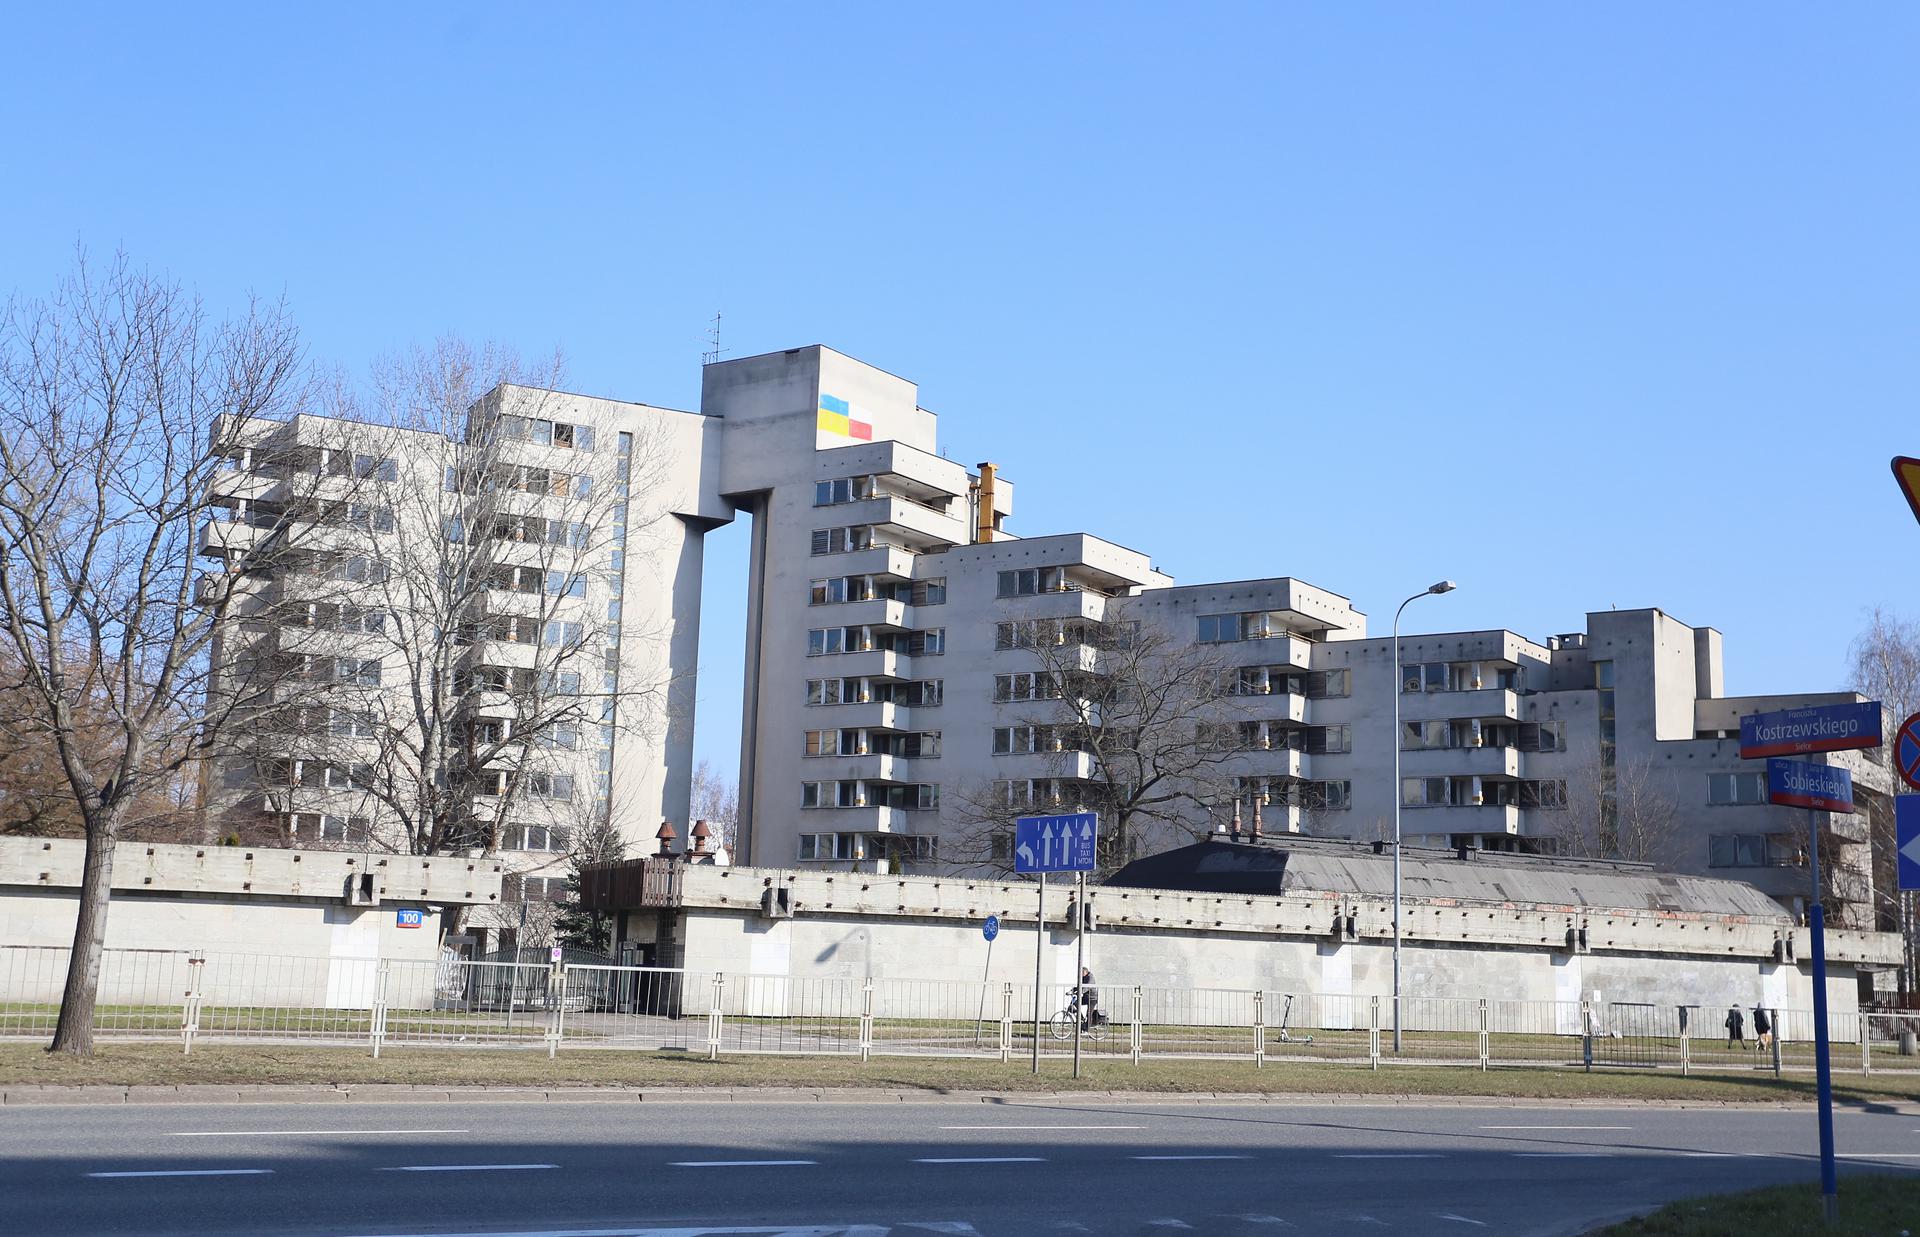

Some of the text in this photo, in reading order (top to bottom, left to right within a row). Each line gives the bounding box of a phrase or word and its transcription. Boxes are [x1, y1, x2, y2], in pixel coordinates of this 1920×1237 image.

[1788, 709, 1817, 719] Franciszka
[1755, 717, 1859, 742] Kostrzewskiego
[1795, 742, 1812, 751] Sielce
[1783, 771, 1846, 800] Sobieskiego
[402, 913, 419, 924] 100
